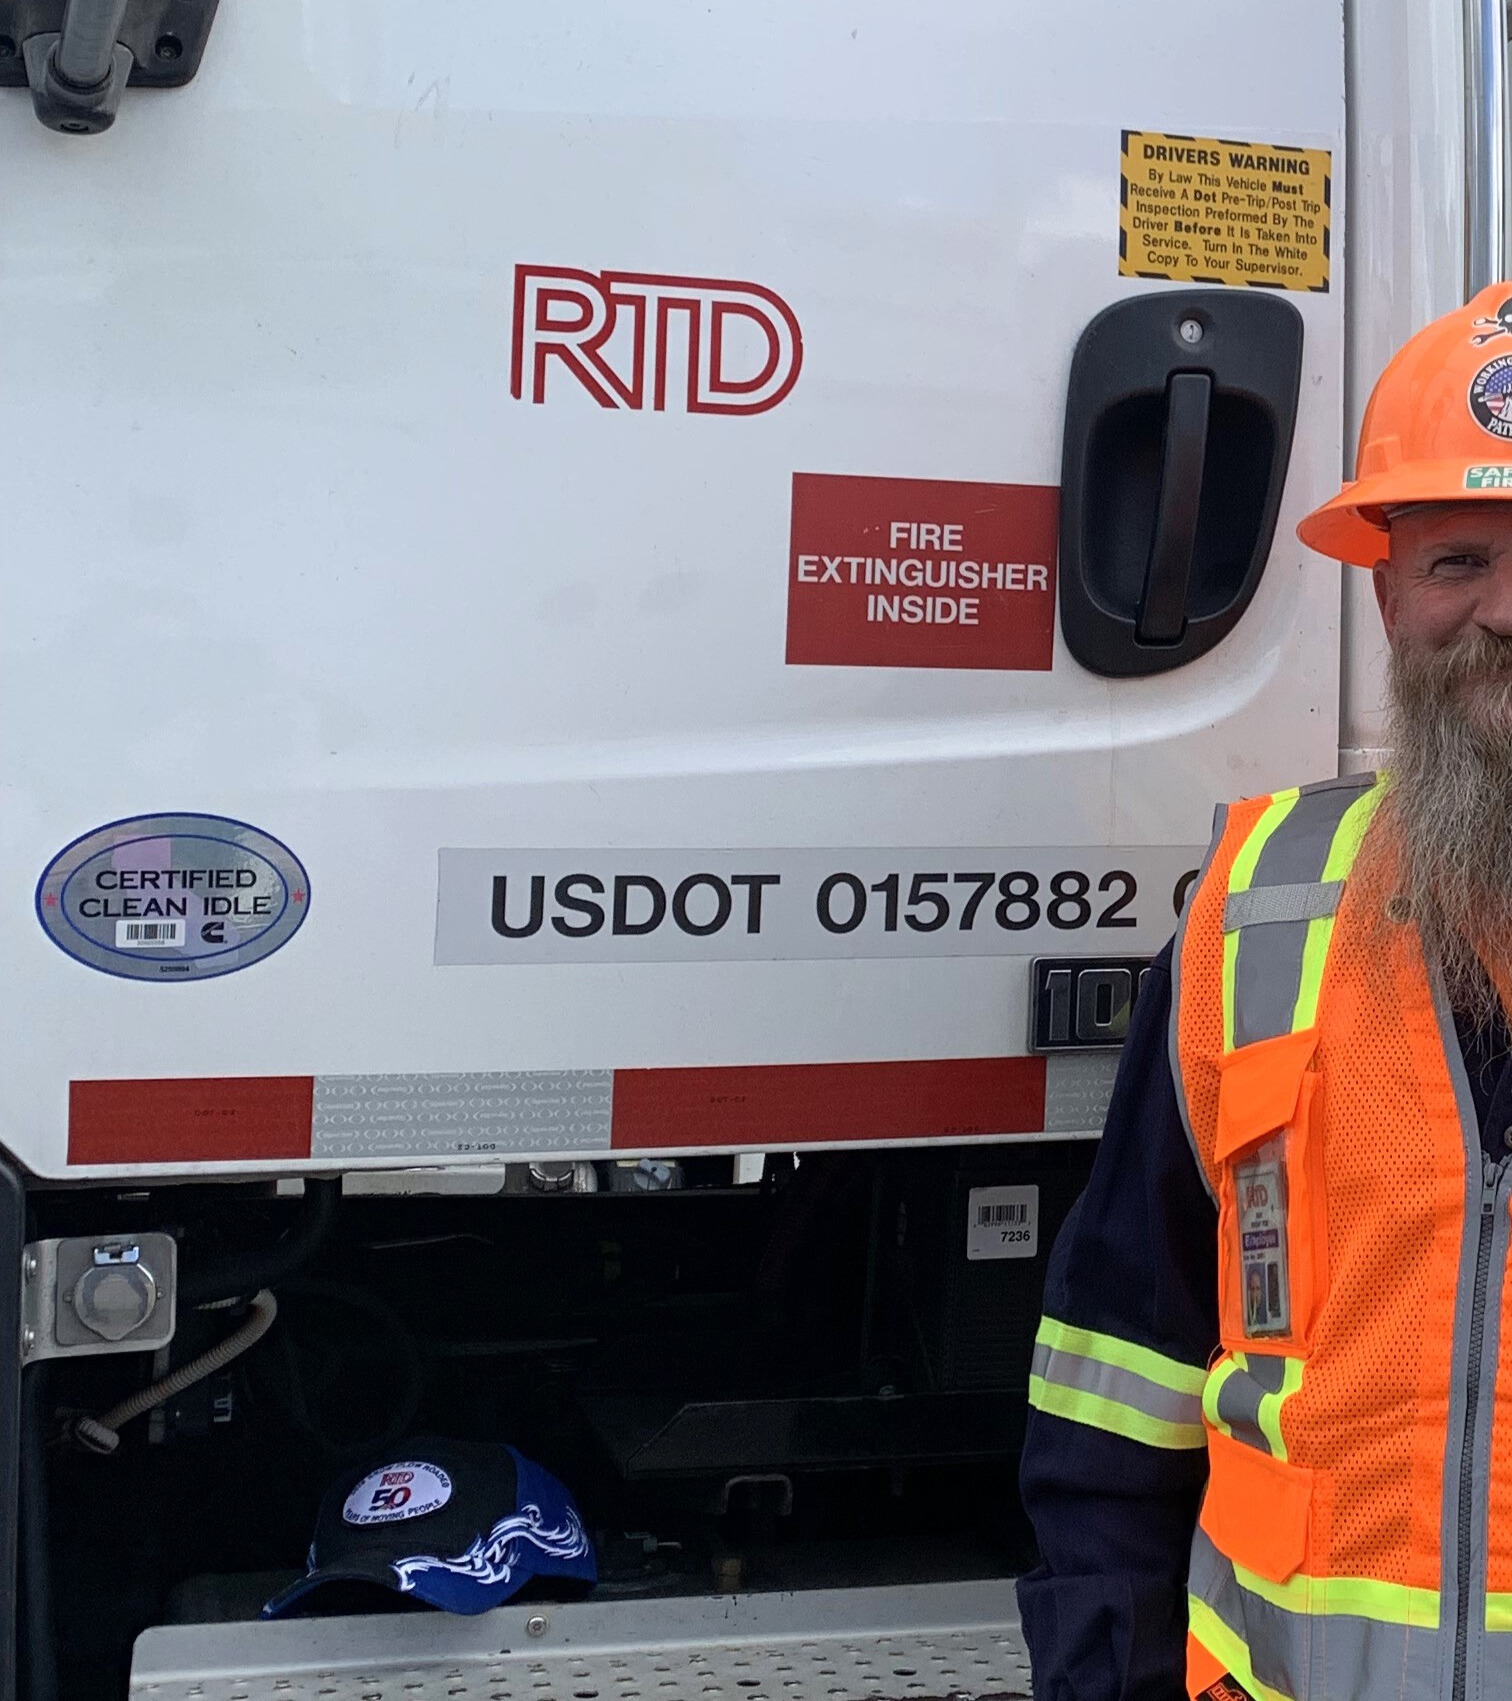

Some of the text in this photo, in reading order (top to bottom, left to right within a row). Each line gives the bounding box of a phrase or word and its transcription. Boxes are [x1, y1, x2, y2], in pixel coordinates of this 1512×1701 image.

[1143, 143, 1310, 175] DRIVERS WARNING
[1148, 168, 1304, 195] By Law This Vehicle Must
[1130, 183, 1321, 215] Receive A Dot Pre-Trip/Post Trip
[1136, 201, 1315, 229] Inspection Preformed By The
[1132, 217, 1318, 246] Driver Before It Is Taken Into
[1142, 234, 1308, 261] Service. Turn In The White
[1147, 251, 1303, 277] Copy To Your Supervisor.
[510, 263, 803, 416] RTD
[890, 521, 964, 552] FIRE
[797, 554, 1049, 591] EXTINGUISHER
[867, 594, 980, 626] INSIDE
[95, 869, 257, 890] CERTIFIED
[79, 896, 272, 917] CLEAN IDLE
[490, 874, 781, 939] USDOT
[815, 870, 1138, 936] 0157882
[1045, 968, 1151, 1041] 10
[1001, 1230, 1031, 1242] 7236
[369, 1486, 412, 1512] 50
[370, 1511, 405, 1522] MOVING
[408, 1498, 443, 1516] PEOPLE
